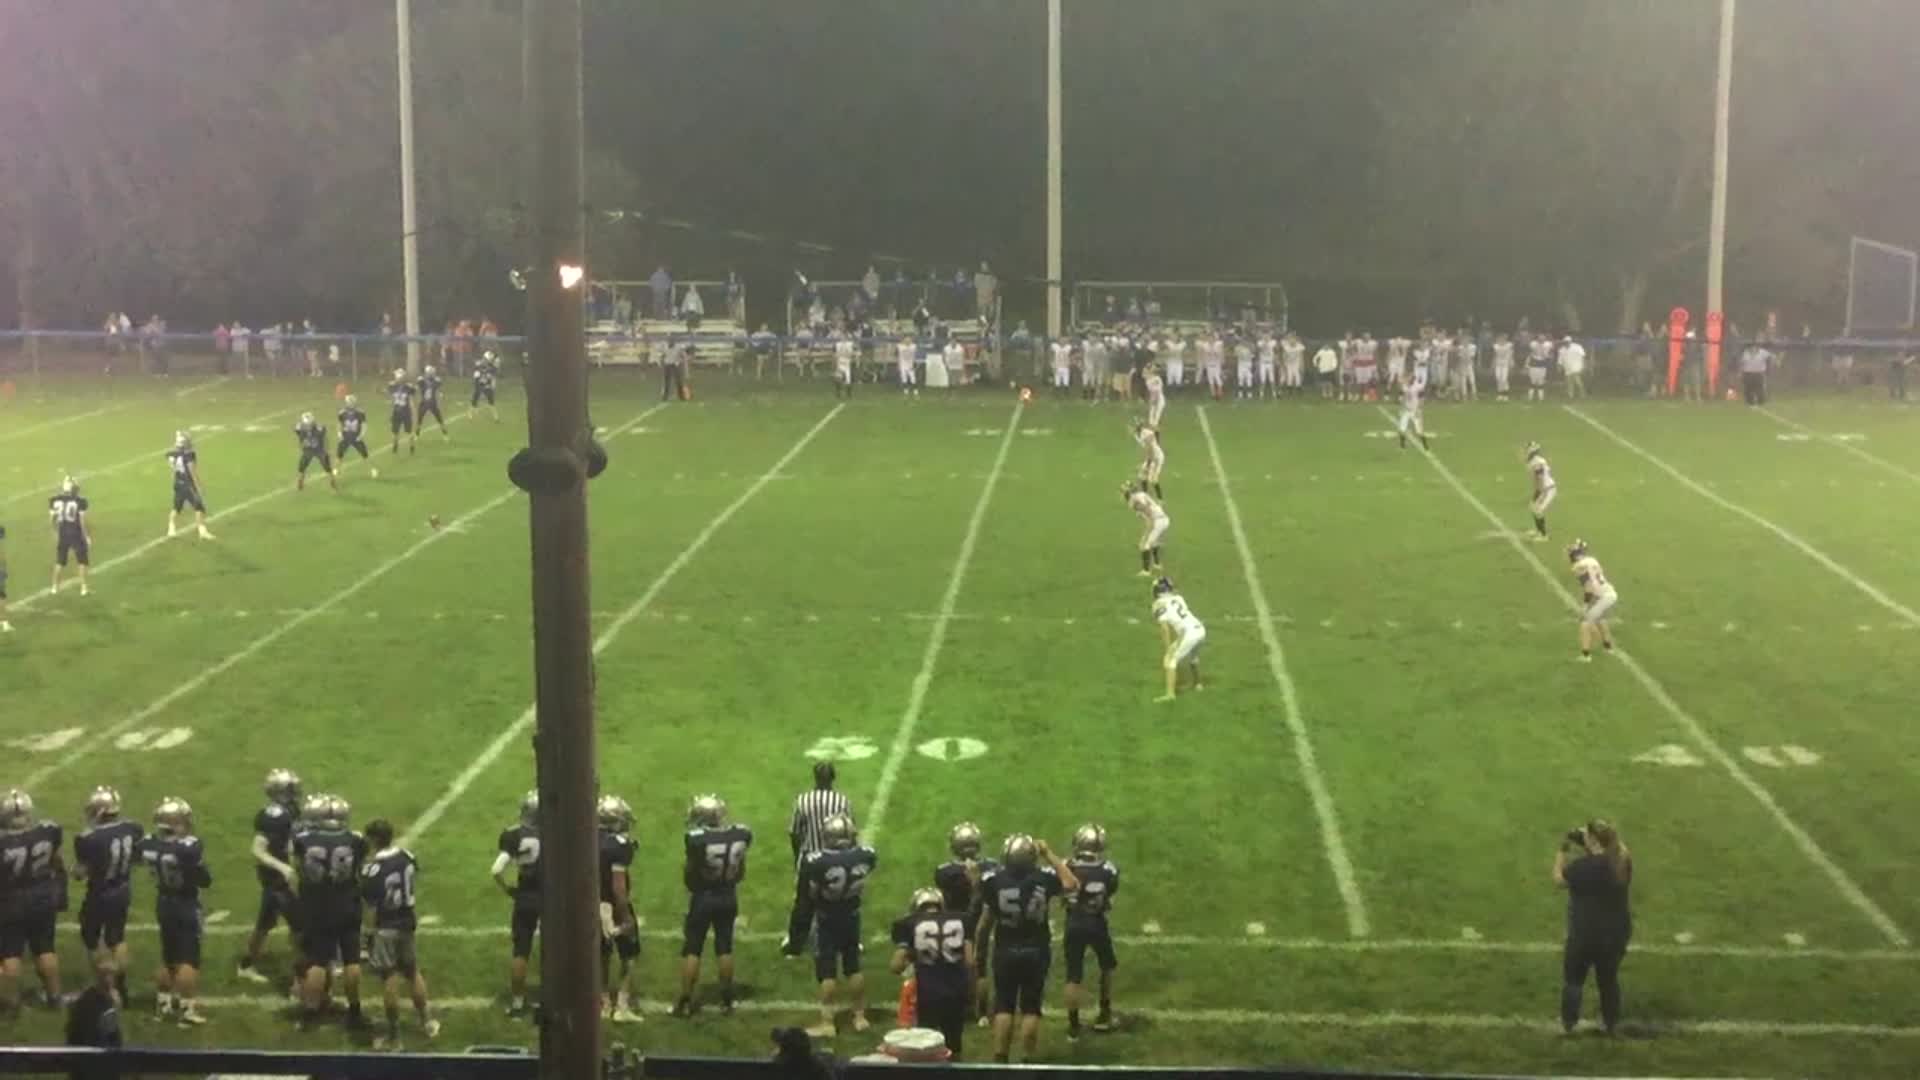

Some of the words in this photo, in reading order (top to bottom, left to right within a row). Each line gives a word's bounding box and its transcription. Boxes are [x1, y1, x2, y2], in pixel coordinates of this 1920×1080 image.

[4, 840, 53, 878] 72
[104, 834, 132, 881] 11
[516, 836, 541, 868] 2
[914, 918, 964, 965] 62
